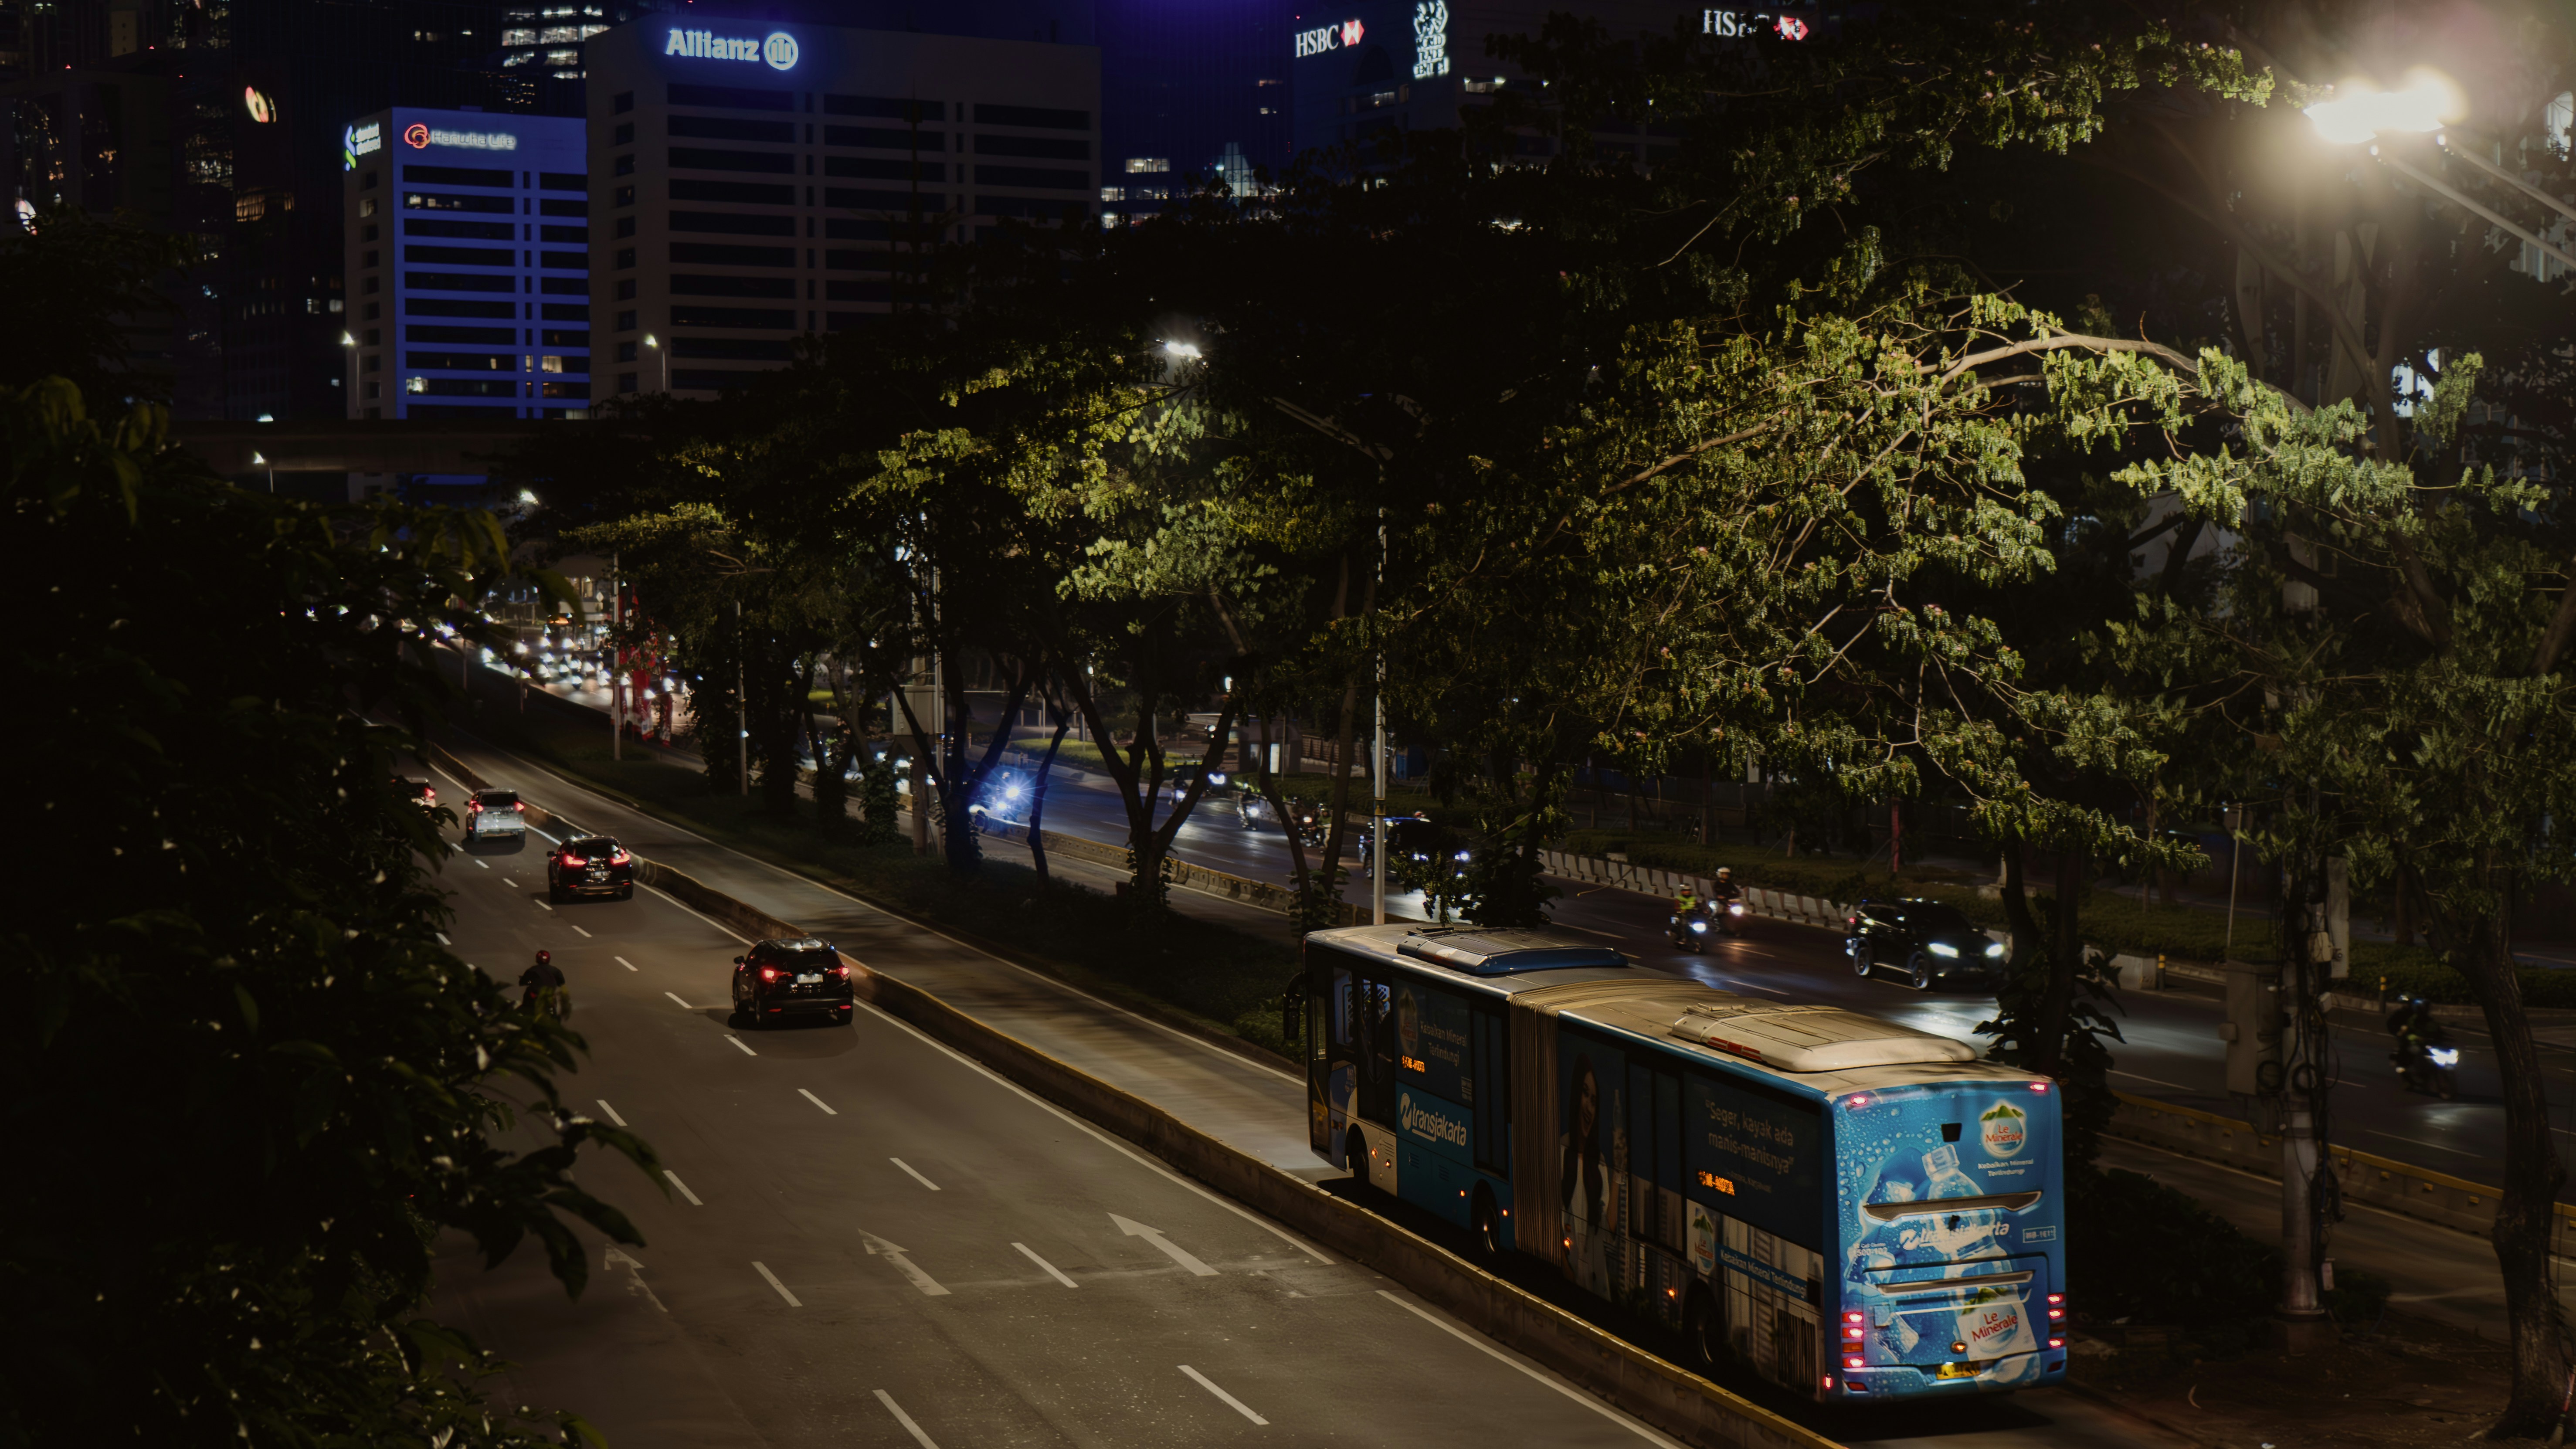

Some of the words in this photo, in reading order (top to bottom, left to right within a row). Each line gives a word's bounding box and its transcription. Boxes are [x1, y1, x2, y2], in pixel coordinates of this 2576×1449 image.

[666, 29, 760, 61] Allianz
[1295, 25, 1339, 58] HSBC
[431, 129, 487, 147] Hanwha
[489, 133, 517, 149] Life
[1412, 1102, 1466, 1147] transjakarta
[1742, 1111, 1772, 1140] kayak
[1774, 1126, 1793, 1147] ada
[1985, 1131, 2023, 1143] Minerale
[1998, 1124, 2009, 1133] Le
[1972, 1314, 2018, 1342] Minerale
[1983, 1312, 1999, 1325] Le
